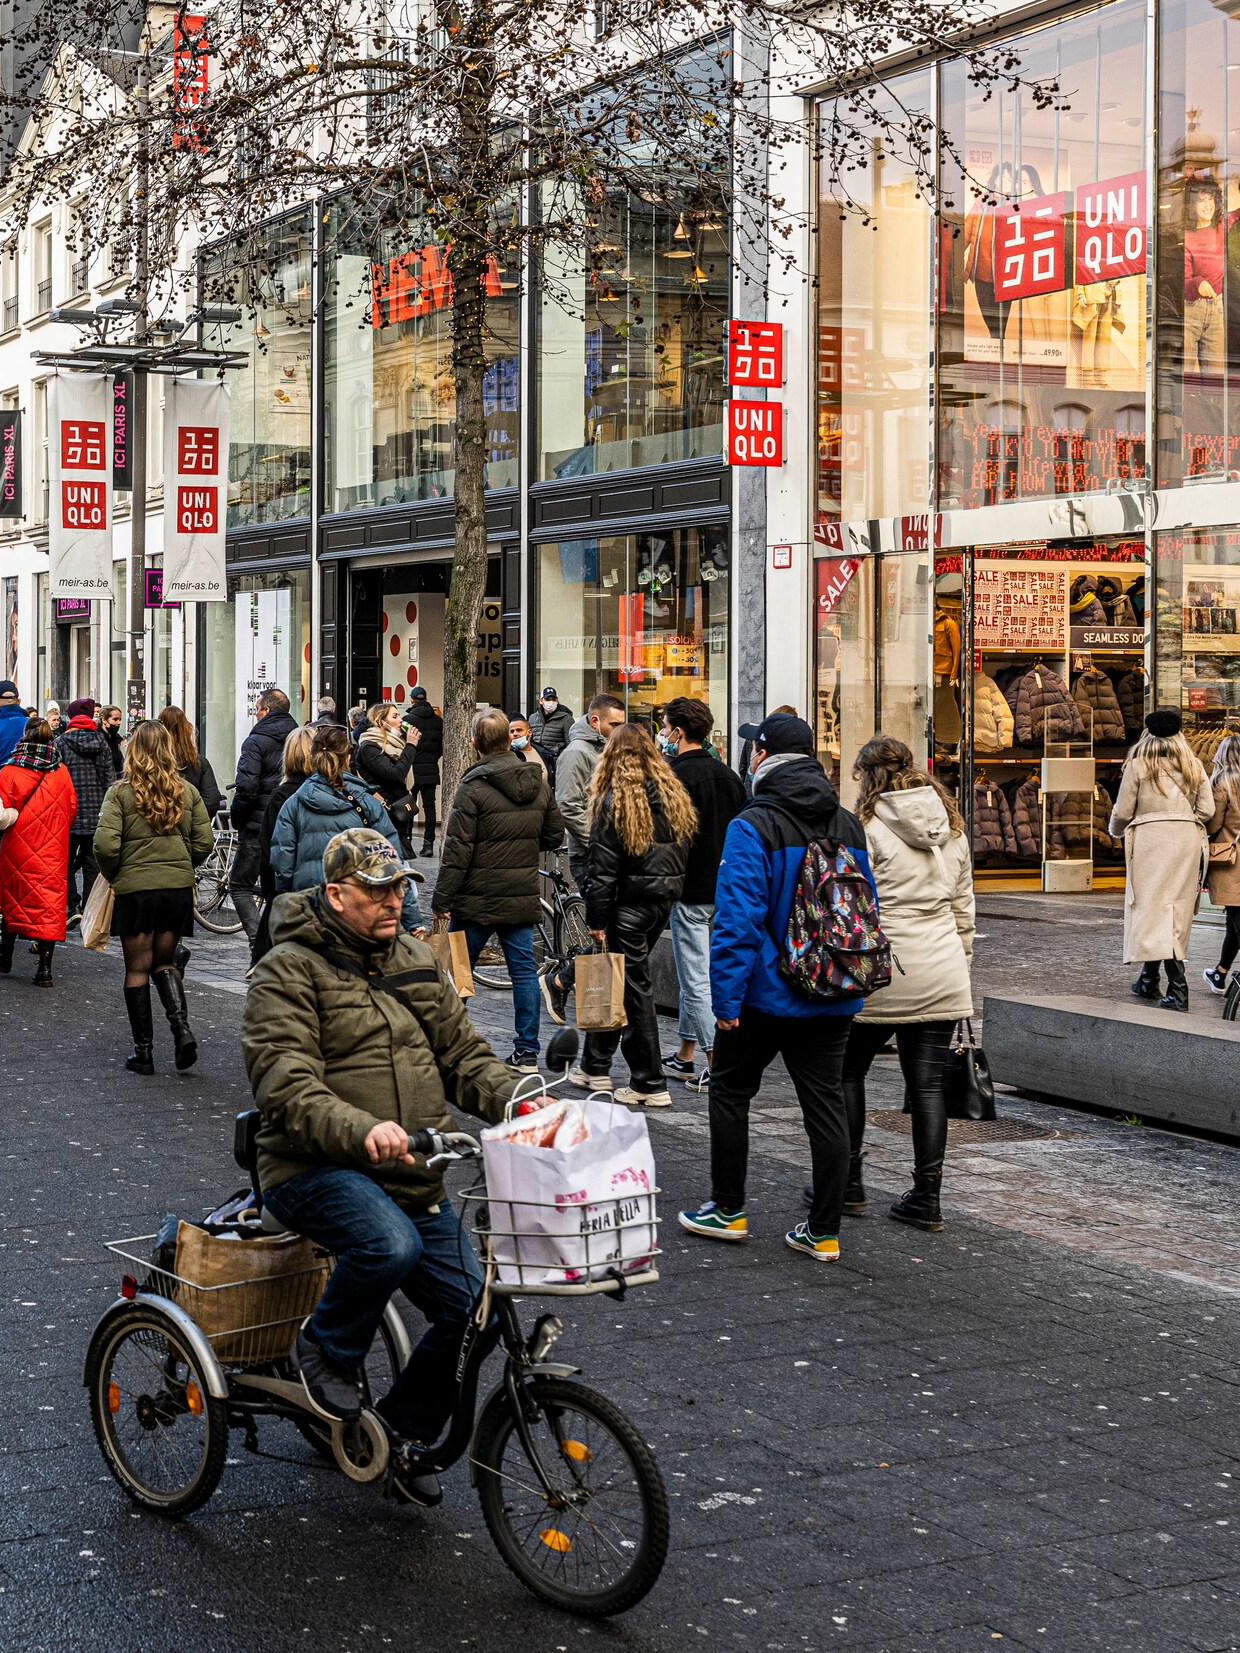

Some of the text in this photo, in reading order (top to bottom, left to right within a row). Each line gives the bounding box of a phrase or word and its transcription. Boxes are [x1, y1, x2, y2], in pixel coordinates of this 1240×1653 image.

[1085, 185, 1139, 229] UNI
[1084, 226, 1143, 274] QLO
[114, 381, 126, 468] ICI PARIS XL
[734, 408, 772, 431] UNI
[734, 435, 777, 461] QLO
[3, 424, 15, 501] ICI PARIS XL
[66, 487, 99, 504] UNI
[182, 491, 211, 508] UNI
[67, 507, 102, 525] QLO
[182, 511, 213, 531] QLO
[58, 577, 109, 588] meir-as.be
[171, 580, 220, 591] meir-as.be
[820, 559, 854, 612] SALE
[1013, 594, 1038, 605] SALE
[1083, 633, 1129, 643] SEAMLESS
